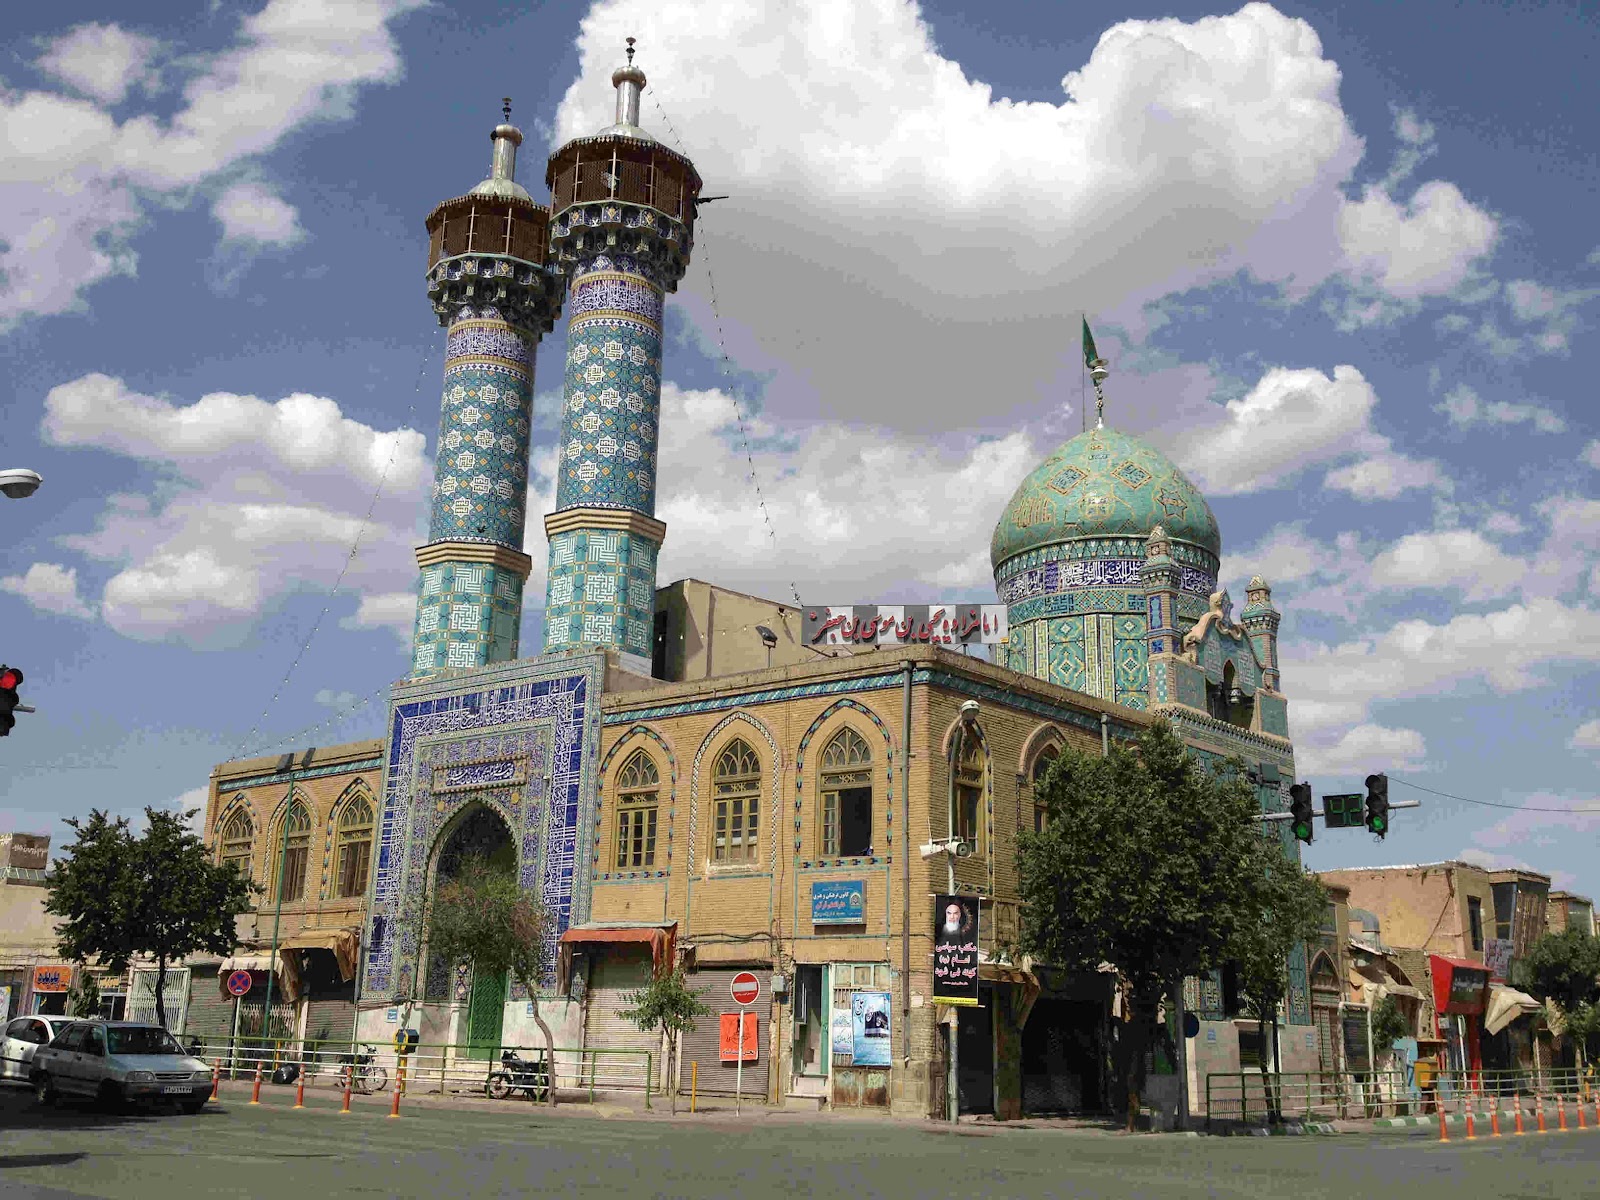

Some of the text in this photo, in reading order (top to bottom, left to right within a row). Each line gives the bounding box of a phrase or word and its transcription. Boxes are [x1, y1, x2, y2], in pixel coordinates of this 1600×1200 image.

[860, 614, 895, 639] موسی
[895, 615, 917, 639] بن
[958, 942, 978, 954] مکتب
[951, 953, 971, 967] امام
